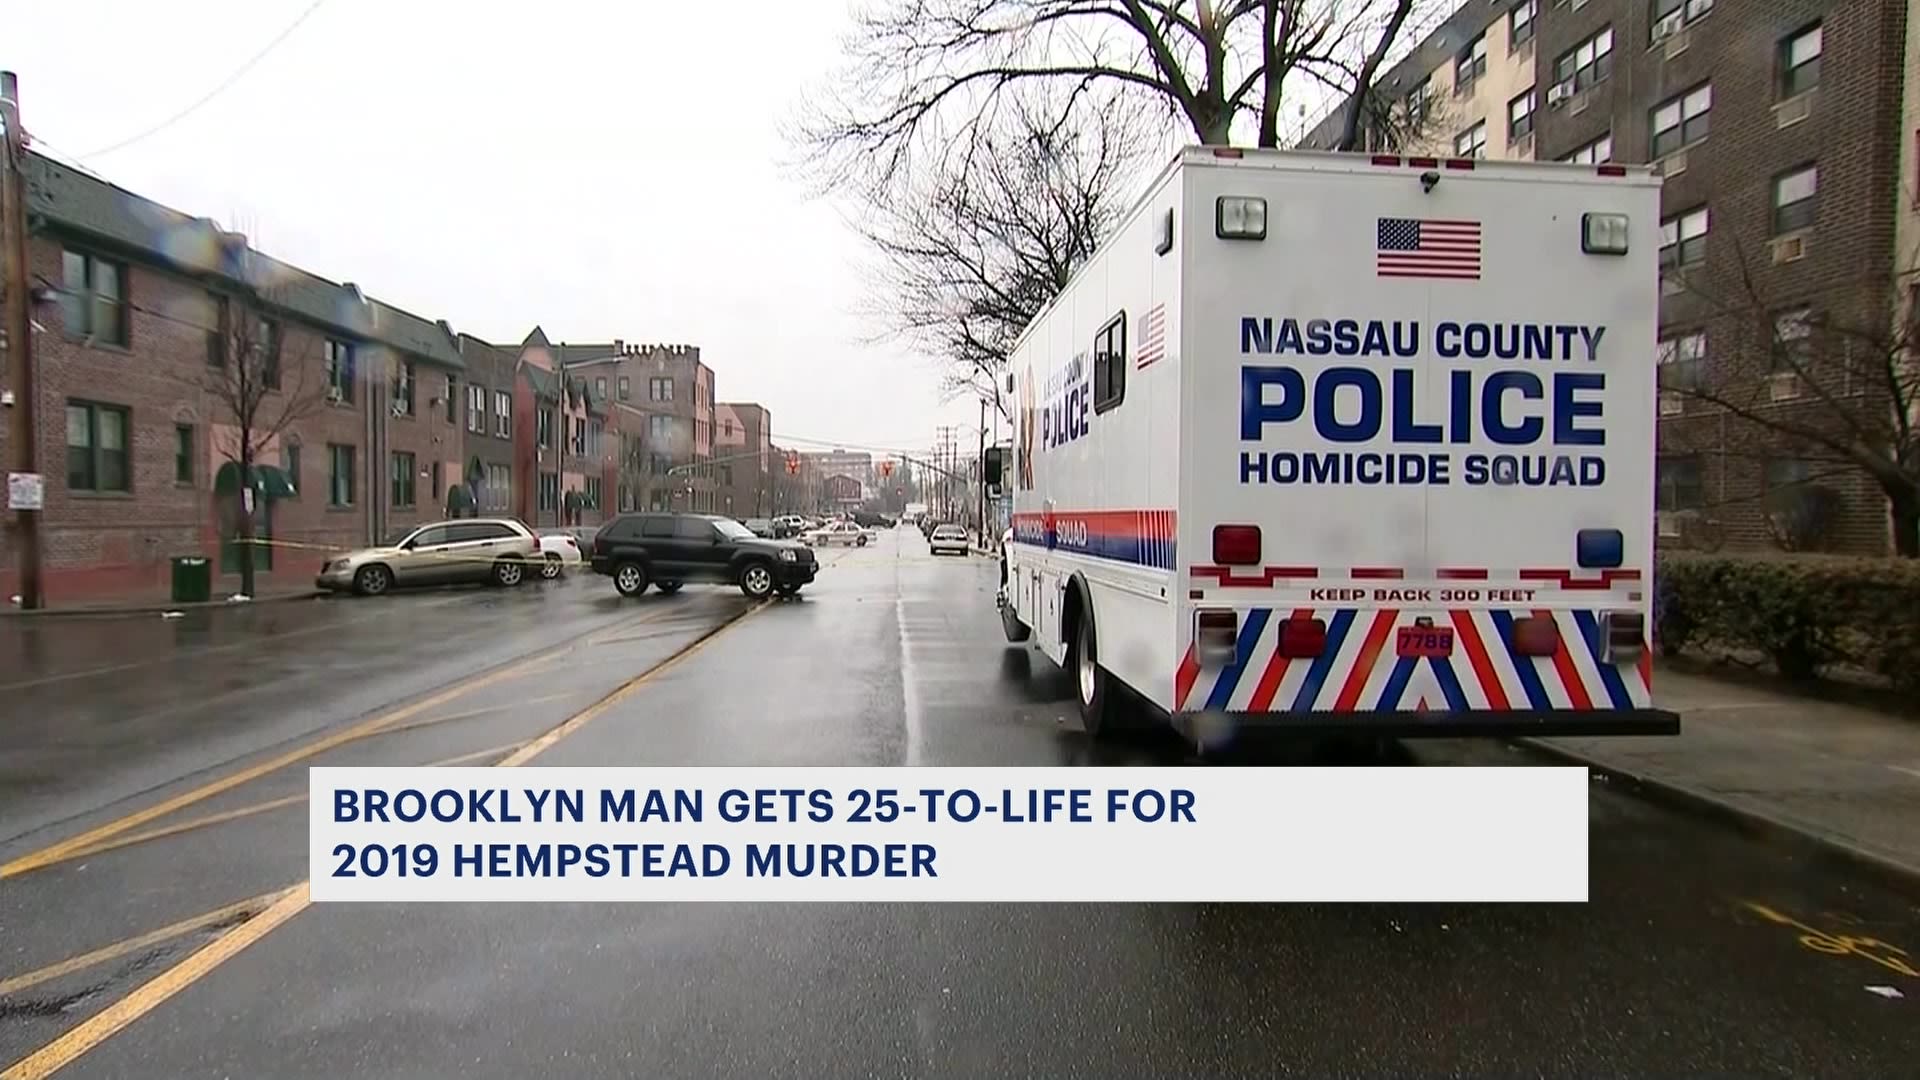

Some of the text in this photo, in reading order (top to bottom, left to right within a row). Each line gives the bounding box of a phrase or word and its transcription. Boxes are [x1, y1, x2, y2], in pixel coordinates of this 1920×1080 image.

[1241, 317, 1606, 361] NASSAU COUNTY
[1043, 381, 1089, 452] POLICE
[1240, 365, 1606, 446] POLICE
[1240, 452, 1606, 486] HOMICIDE SQUAD
[1055, 518, 1088, 546] SQUAD
[1310, 588, 1536, 602] KEEP BACK 300 FEET
